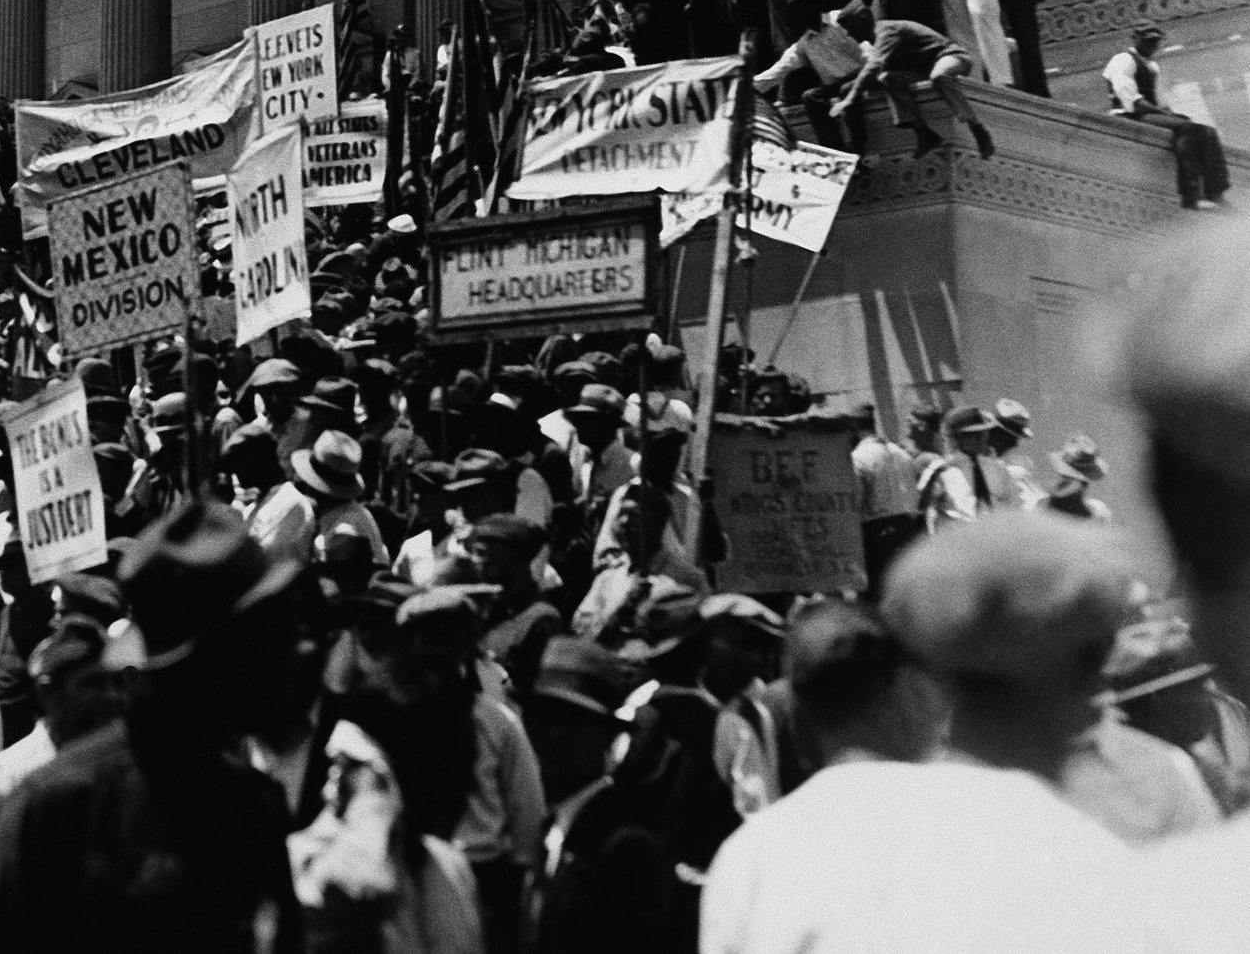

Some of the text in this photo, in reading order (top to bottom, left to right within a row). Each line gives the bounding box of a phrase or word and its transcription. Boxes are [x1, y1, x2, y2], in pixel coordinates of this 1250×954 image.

[261, 64, 283, 92] EW
[56, 122, 226, 189] CLEVELAND
[307, 138, 377, 163] VETERANS
[82, 187, 157, 241] NEW
[234, 174, 288, 238] NRTH
[61, 222, 181, 287] MEXICO
[440, 225, 630, 274] FLINT MICHIGAN
[72, 275, 186, 328] DIVISION
[467, 264, 634, 307] HEADQUARTERS
